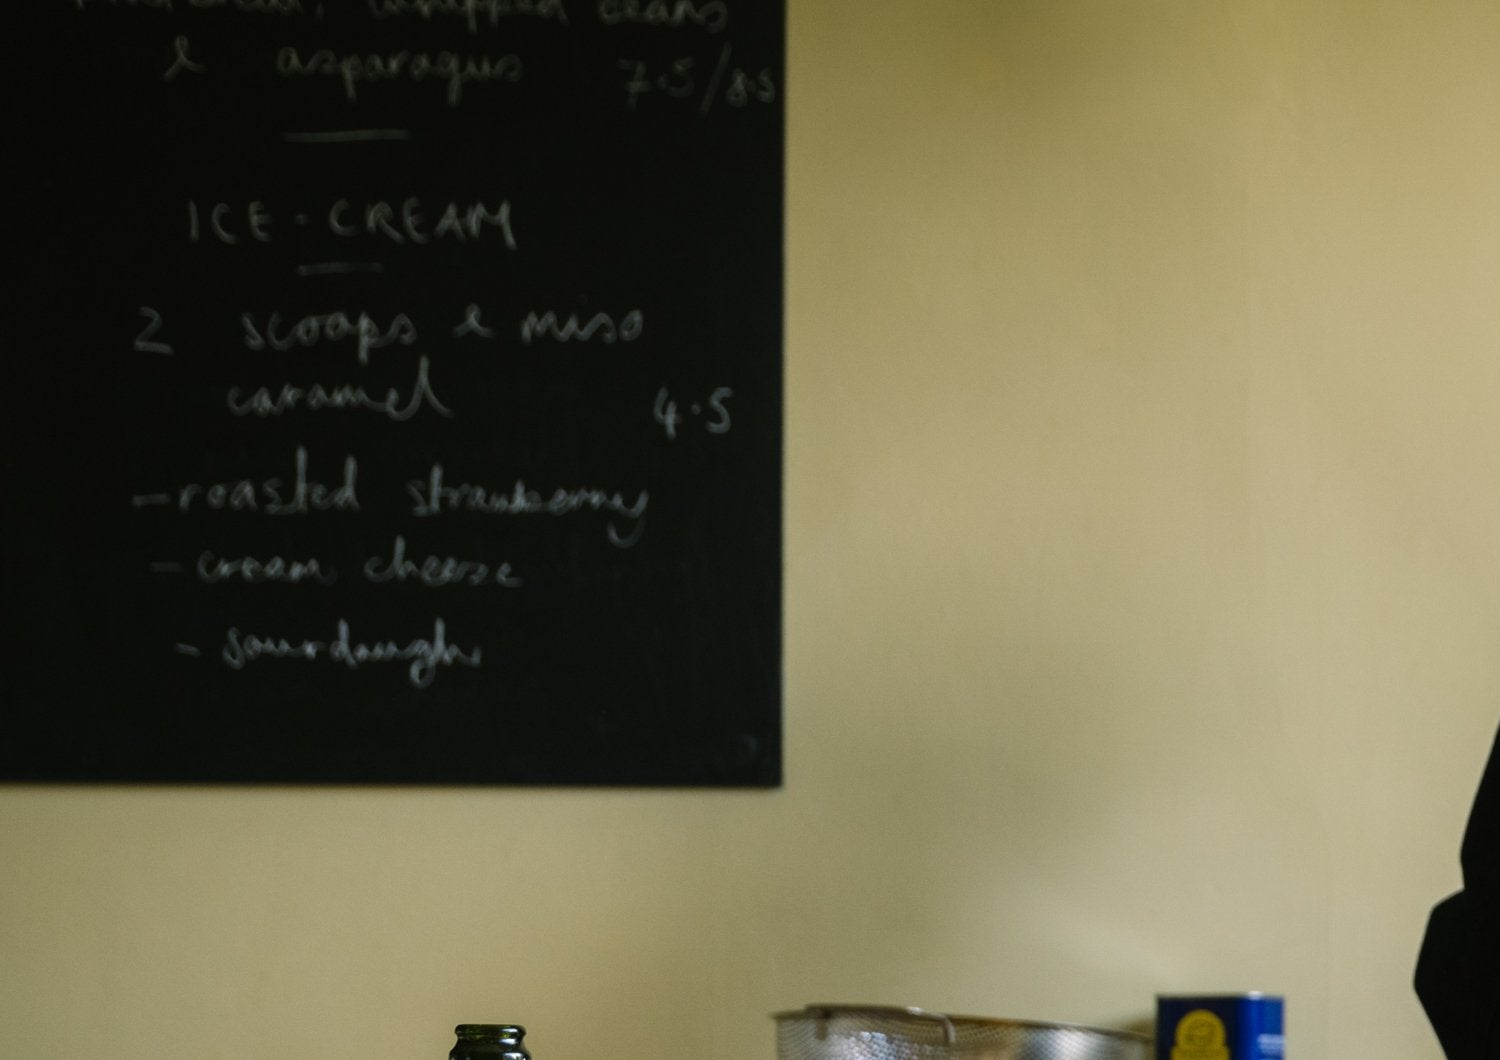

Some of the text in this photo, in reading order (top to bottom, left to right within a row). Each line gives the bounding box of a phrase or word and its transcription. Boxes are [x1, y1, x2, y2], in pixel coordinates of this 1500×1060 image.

[276, 46, 523, 104] asparagus
[134, 306, 176, 356] 2
[241, 310, 418, 364] scoops
[520, 308, 645, 345] miso
[226, 354, 456, 423] caramel
[178, 446, 361, 516] roasted
[405, 463, 649, 549] strawberry
[198, 550, 337, 587] cream
[364, 535, 524, 588] cheese
[222, 618, 482, 690] sourdough
